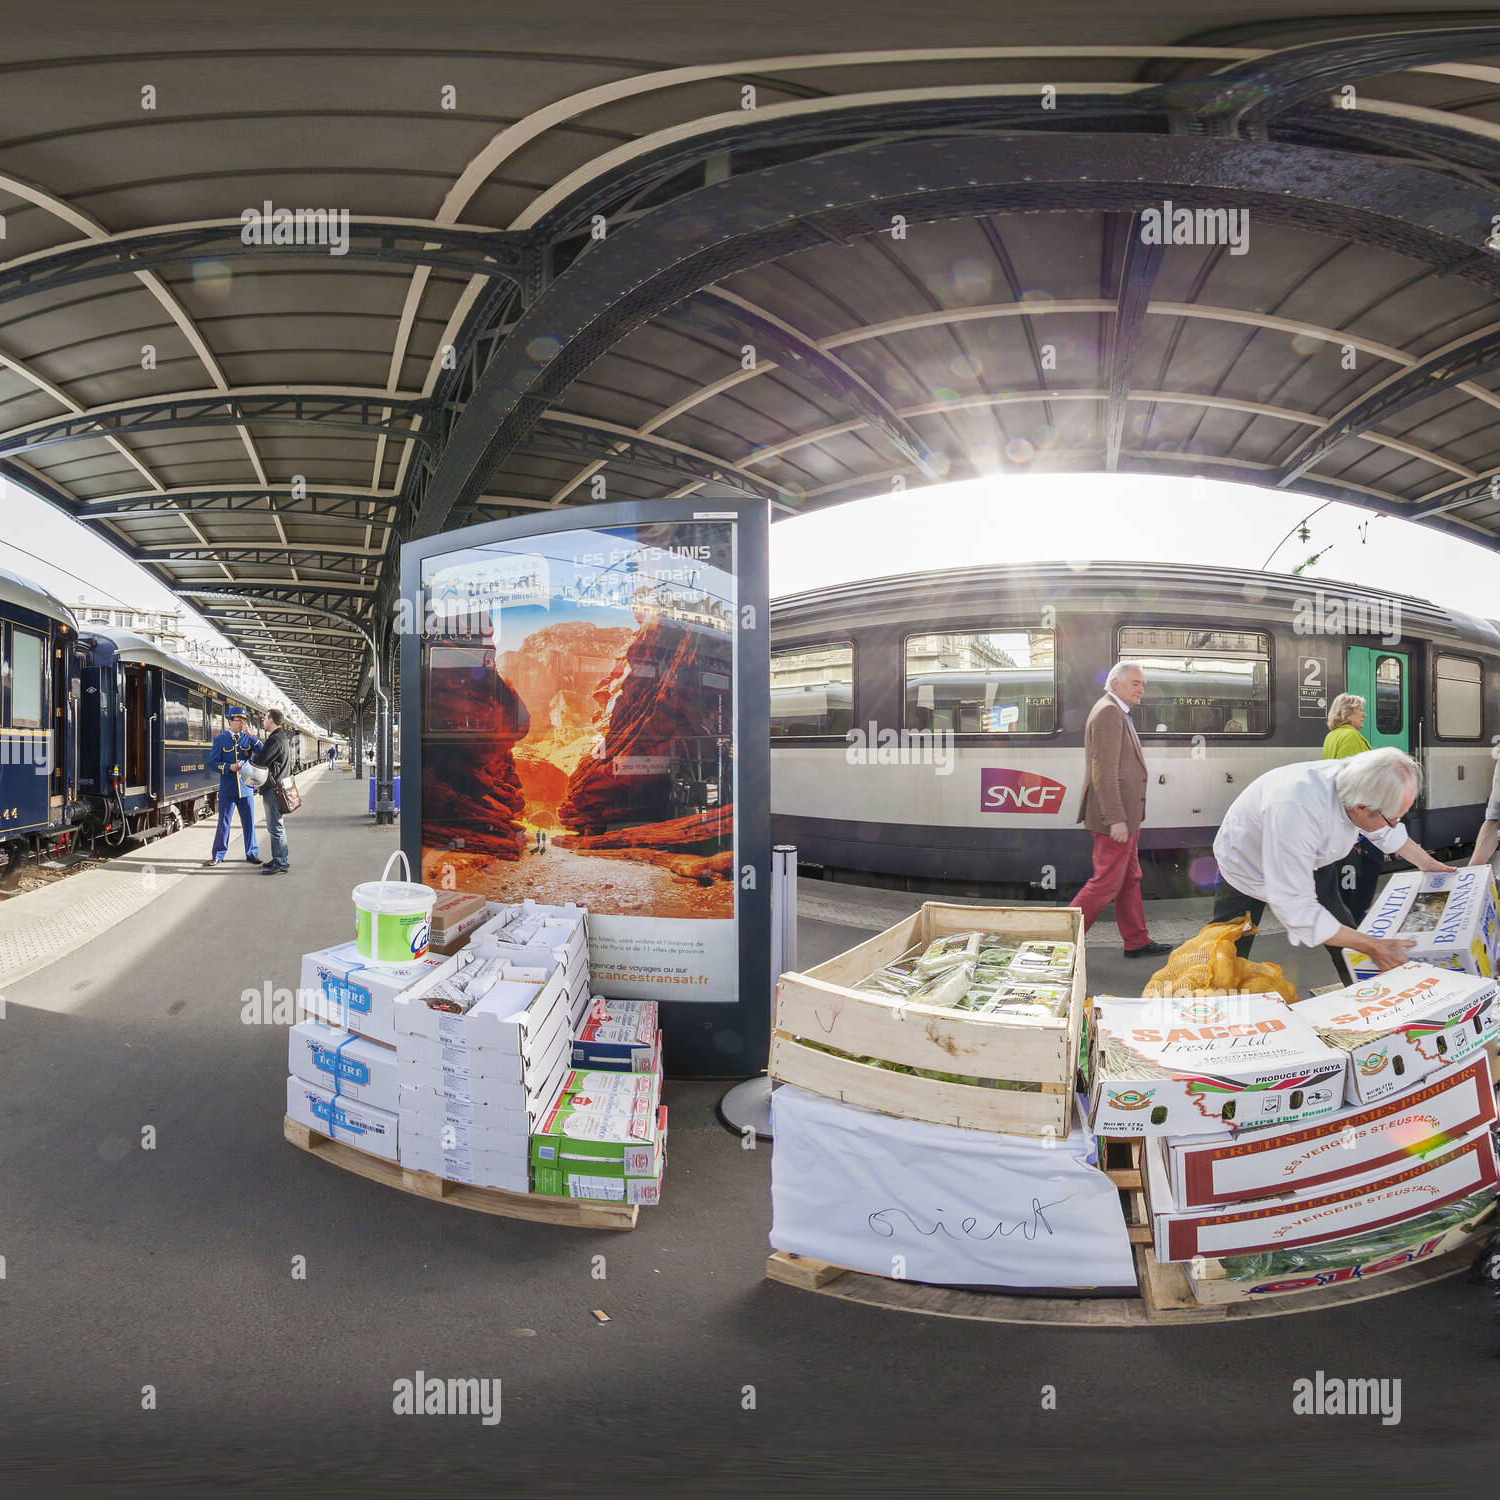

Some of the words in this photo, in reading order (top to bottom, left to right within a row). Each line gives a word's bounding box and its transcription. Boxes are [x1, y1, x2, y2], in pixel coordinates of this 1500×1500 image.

[573, 552, 605, 568] LES
[1303, 658, 1321, 687] 2
[984, 785, 1061, 808] SNCF
[1366, 884, 1412, 940] BONITA
[1433, 872, 1476, 945] BANANAS
[616, 963, 627, 971] de
[629, 965, 661, 973] voyages
[1329, 977, 1440, 1025] SACCO
[1447, 1002, 1472, 1020] PRODUCE
[1480, 989, 1496, 1002] KENYA
[1131, 1019, 1287, 1043] SACCO
[1160, 1037, 1218, 1053] Fresh
[1230, 1031, 1273, 1048] Ltd
[1450, 1046, 1470, 1061] Extra
[1255, 1071, 1297, 1084] PRODUCE
[1299, 1068, 1311, 1077] OF
[1313, 1063, 1341, 1074] KENYA
[1214, 1134, 1297, 1160] FRUITS
[1400, 1066, 1477, 1109] PRIMEURS
[1239, 1118, 1274, 1128] Extra
[1282, 1159, 1302, 1177] LES
[1199, 1205, 1281, 1225] FRUITS
[1293, 1181, 1388, 1212] LEGUMES
[1398, 1140, 1479, 1183] PRIMEURS
[1271, 1225, 1293, 1239] LES
[1292, 1201, 1363, 1226] VERGERS
